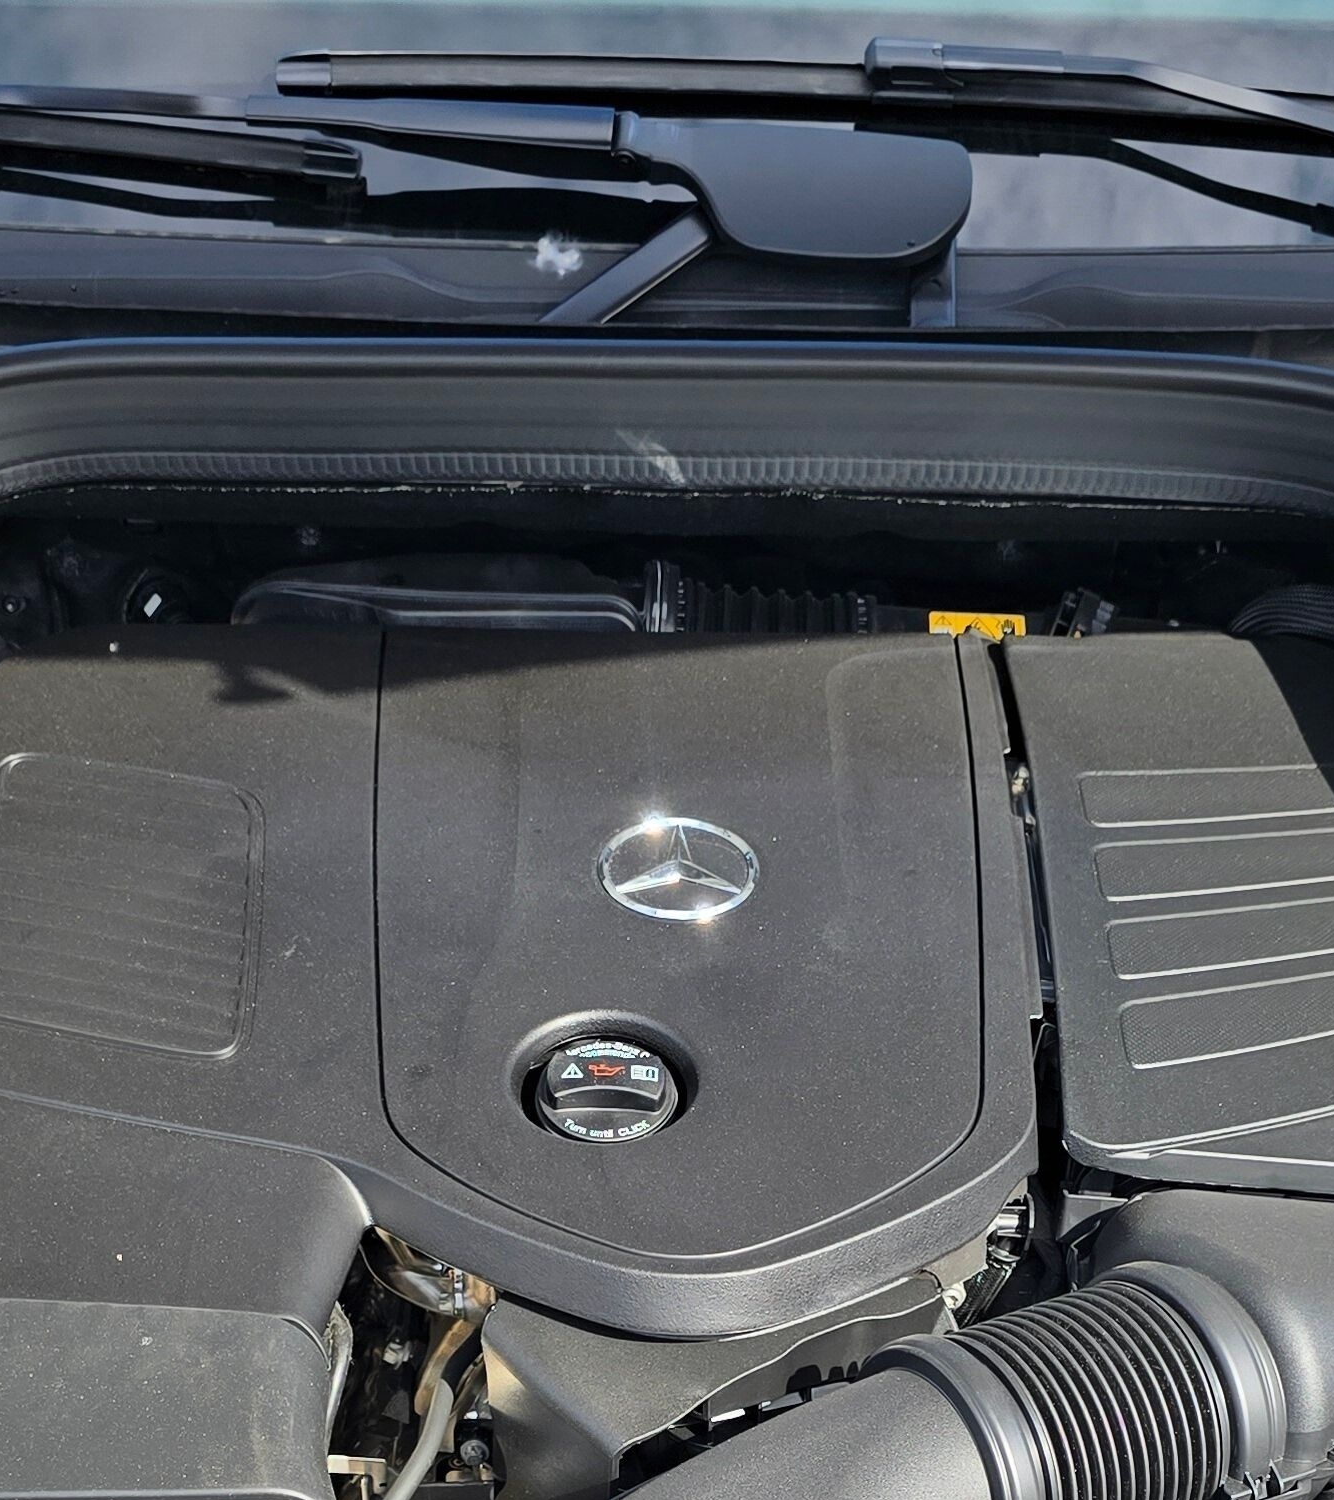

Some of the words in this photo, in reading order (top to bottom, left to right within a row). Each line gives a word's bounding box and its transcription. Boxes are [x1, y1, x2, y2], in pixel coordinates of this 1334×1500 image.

[564, 1118, 586, 1135] Turn
[589, 1128, 614, 1138] until
[618, 1119, 650, 1136] CLICK
